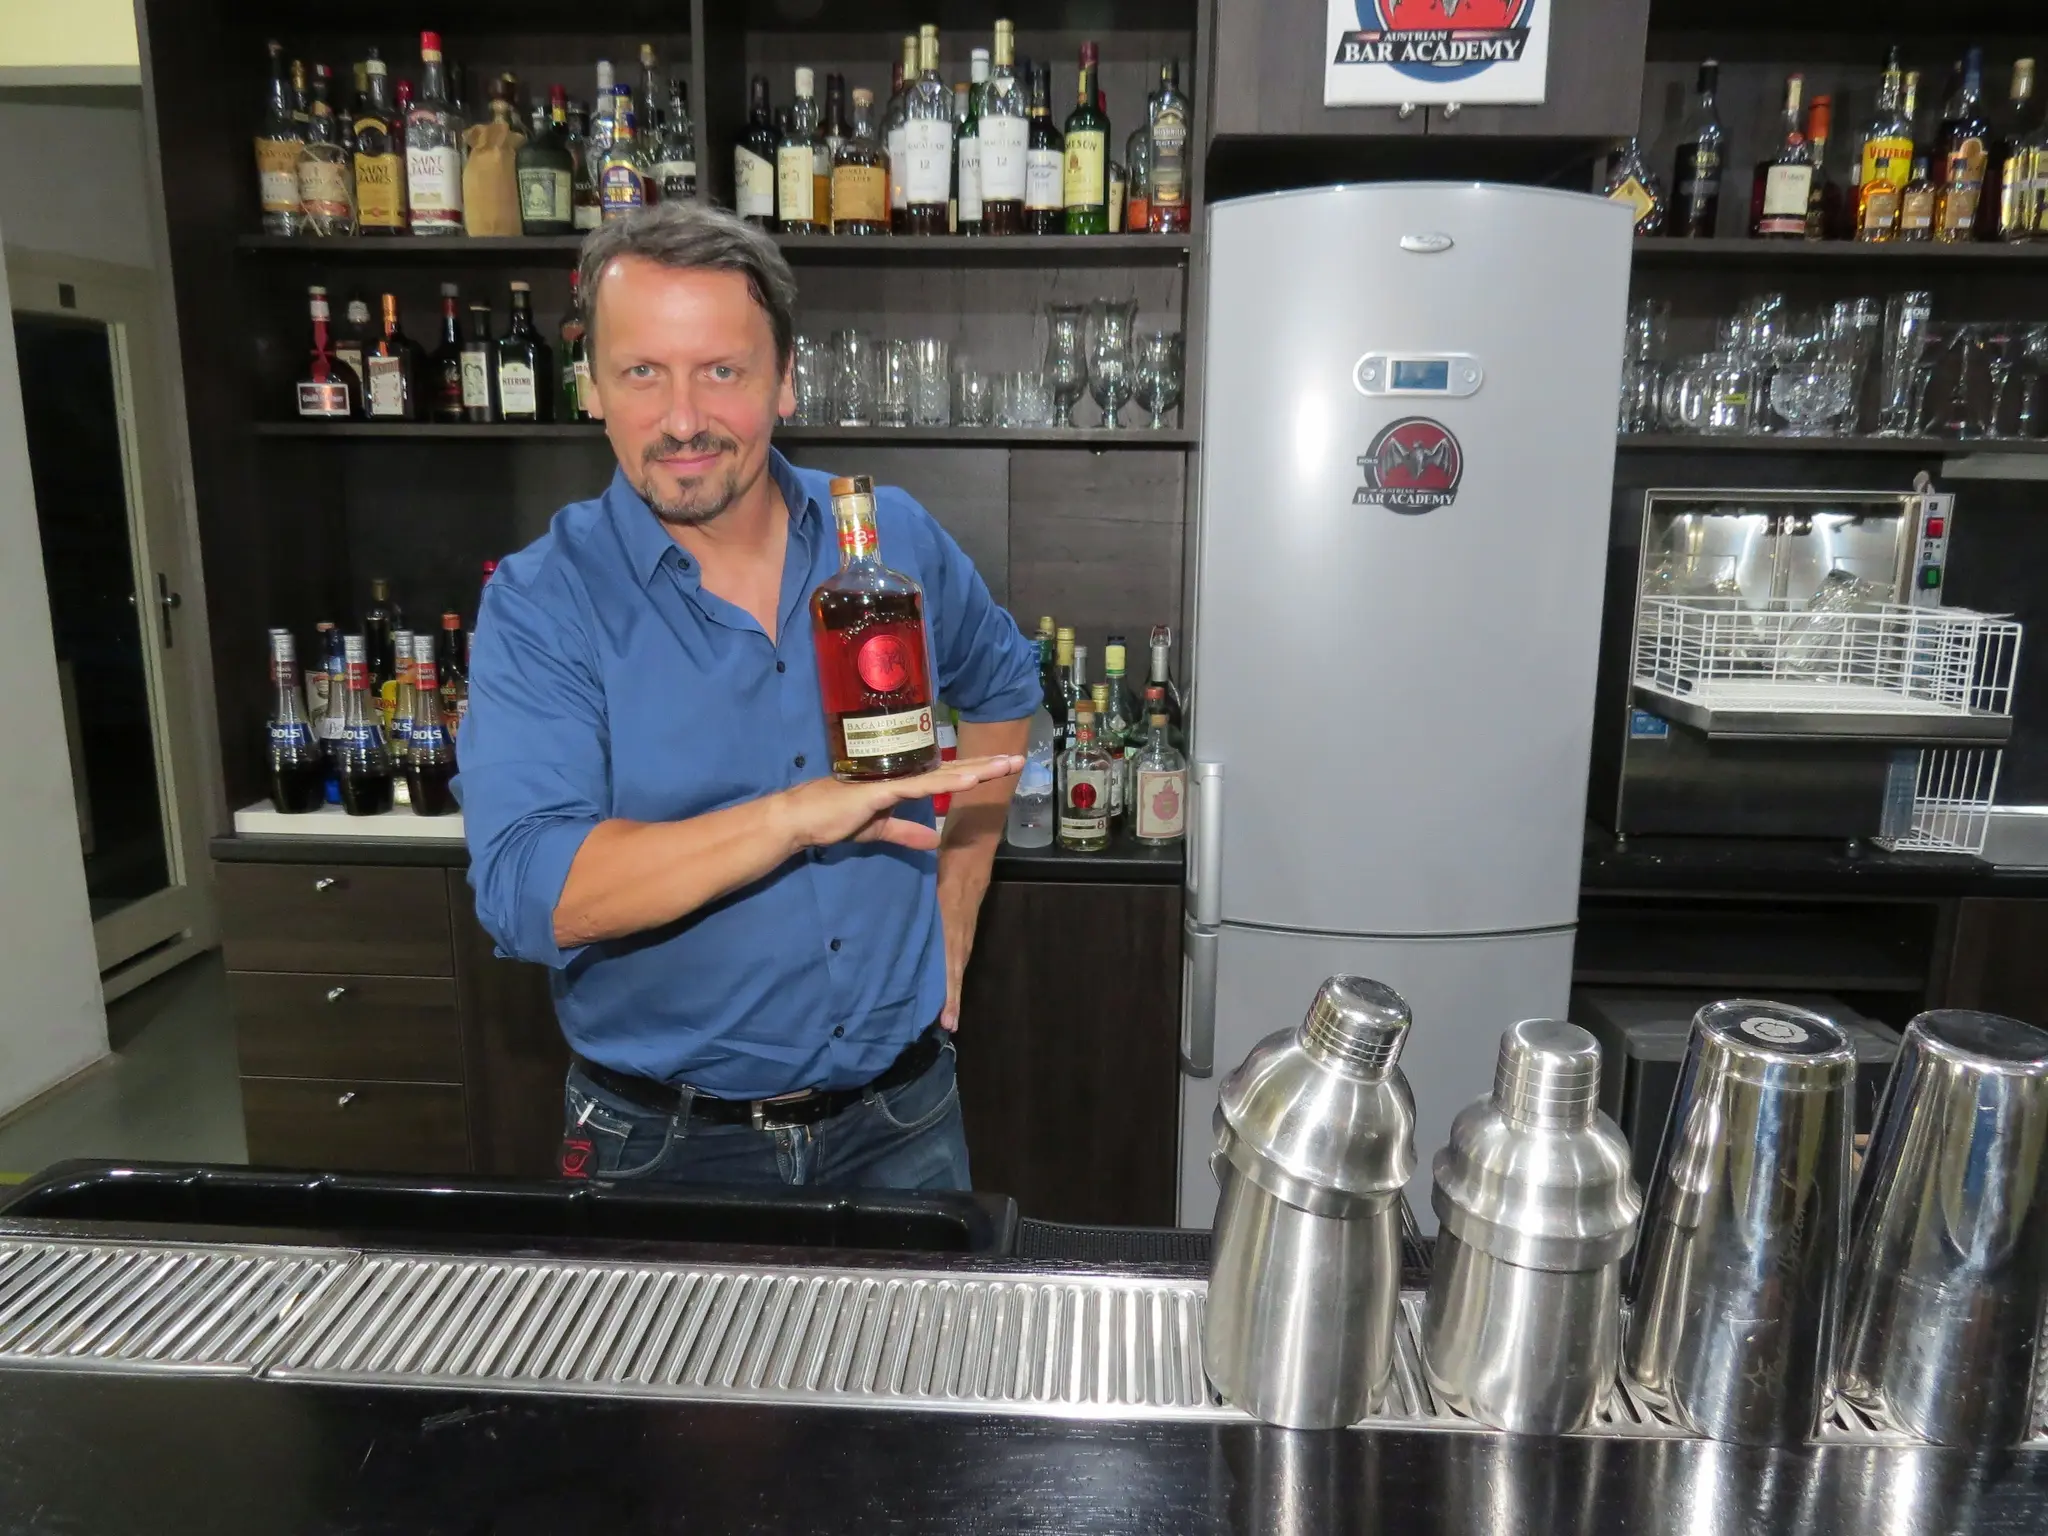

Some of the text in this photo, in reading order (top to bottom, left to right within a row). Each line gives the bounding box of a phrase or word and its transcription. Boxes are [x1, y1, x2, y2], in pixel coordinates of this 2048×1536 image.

[1384, 31, 1448, 42] AUSTRIAN
[1344, 39, 1521, 62] BAR ACADEMY
[410, 156, 441, 166] SAINT
[919, 160, 930, 170] 12
[996, 157, 1007, 167] 12
[358, 166, 388, 176] SAINT
[409, 166, 444, 177] JAMES
[358, 174, 393, 184] JAMES
[1357, 493, 1455, 505] BAR ACADEMY
[391, 721, 413, 732] OLS
[846, 718, 897, 731] BACARDI
[919, 712, 931, 732] 8
[271, 728, 300, 738] BOLS
[342, 730, 369, 740] BOLS
[412, 729, 442, 740] BOLS
[1096, 819, 1105, 830] 8
